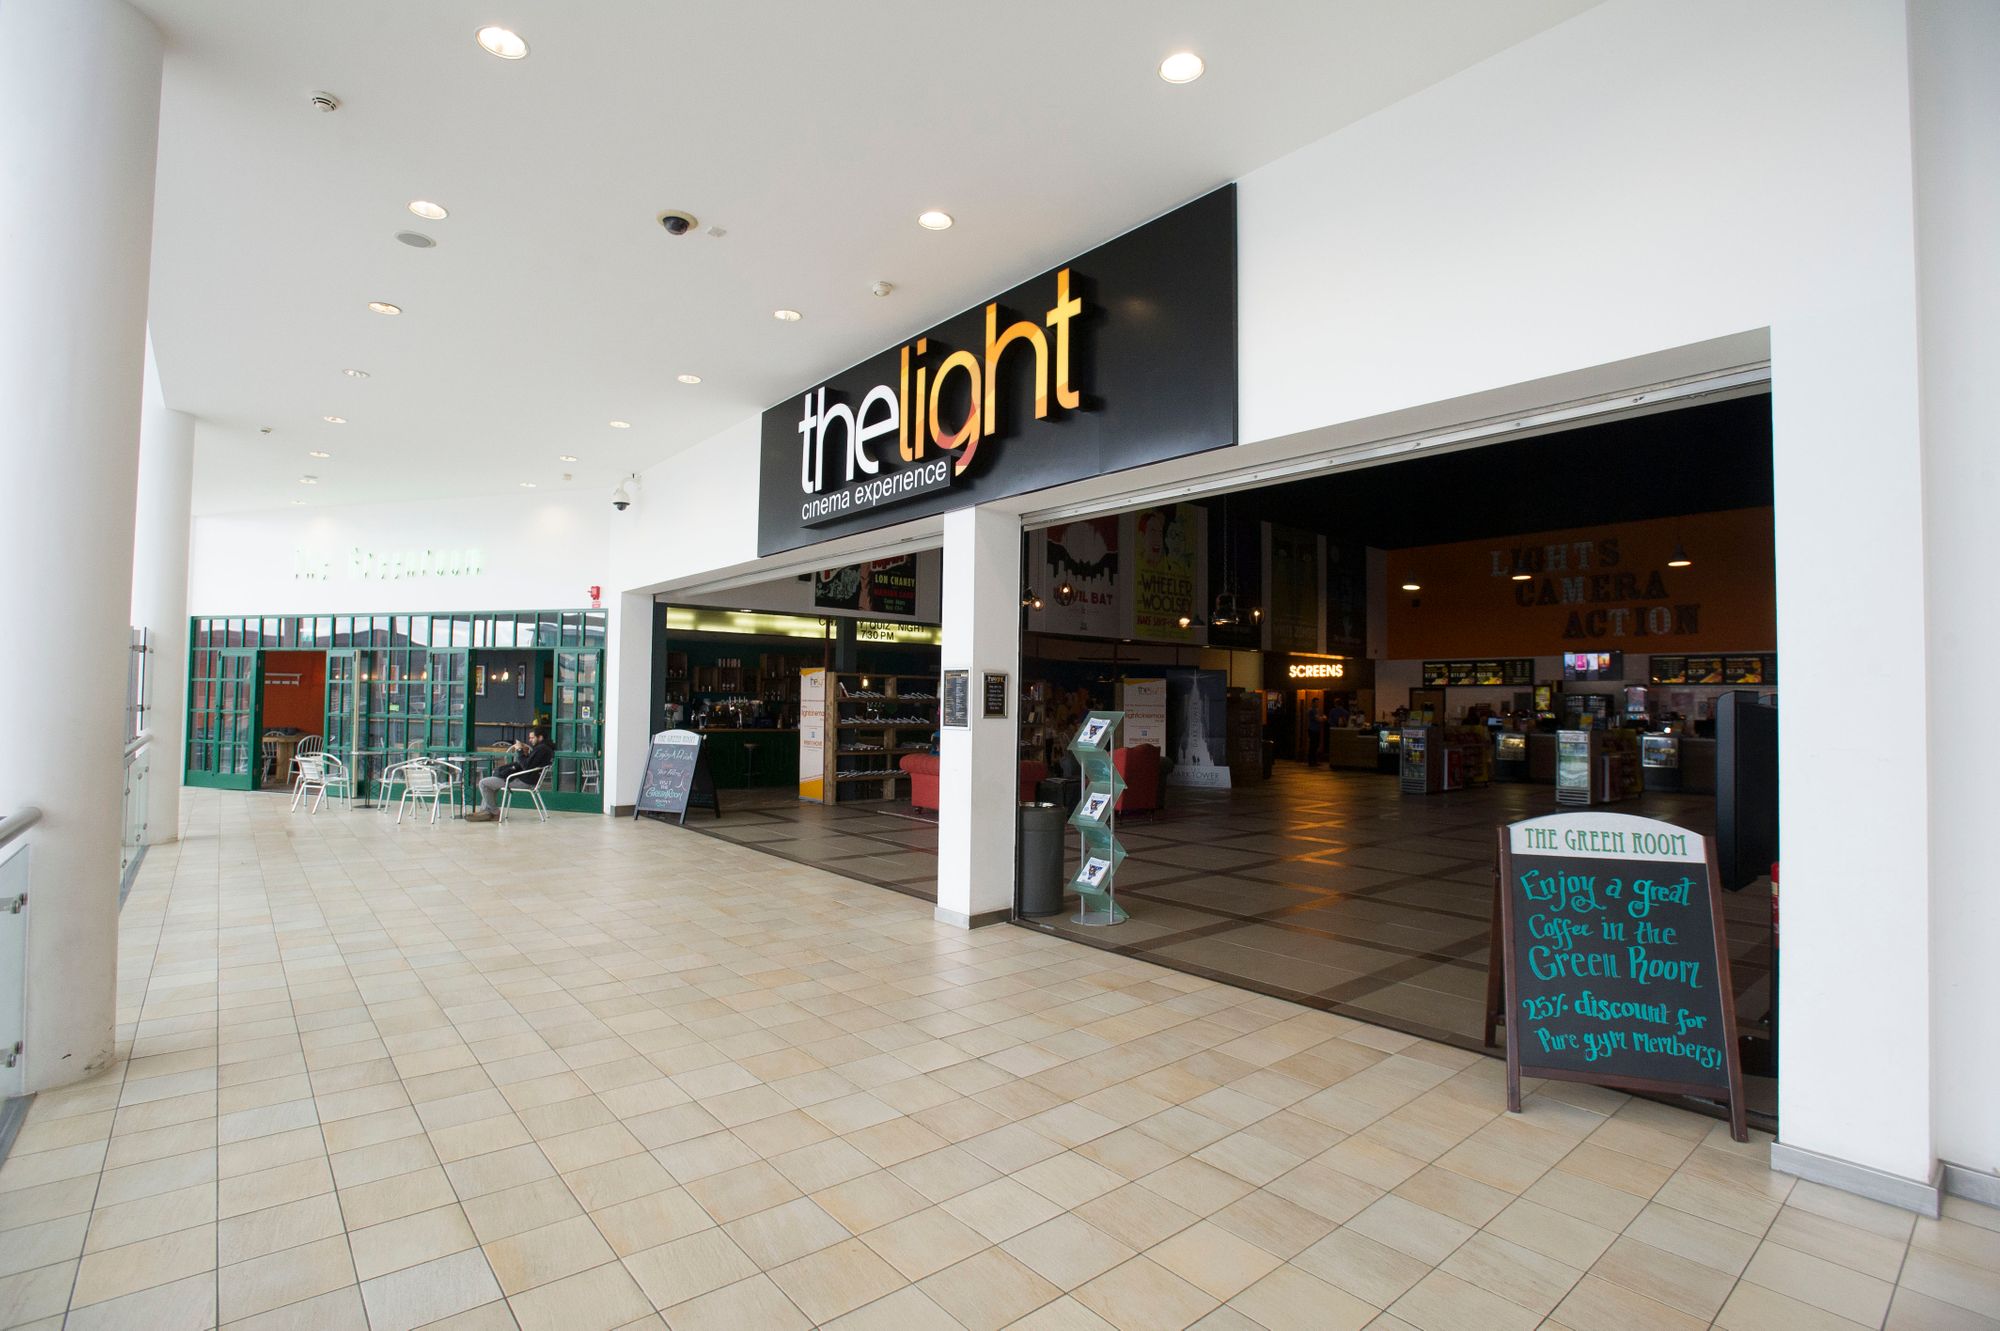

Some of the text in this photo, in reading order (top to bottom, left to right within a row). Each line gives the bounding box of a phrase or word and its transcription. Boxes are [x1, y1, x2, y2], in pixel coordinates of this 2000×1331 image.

[802, 461, 947, 520] cinema experience
[875, 574, 916, 588] LON CHANEY
[1514, 570, 1671, 607] CAMERA
[1091, 592, 1113, 606] BAT
[869, 622, 891, 631] QUIZ
[897, 624, 926, 633] NIGHT
[880, 631, 895, 641] PM
[1561, 603, 1701, 640] ACTION
[1288, 664, 1344, 678] SCREENS
[1525, 828, 1688, 856] THE GREEN ROOM
[1520, 869, 1697, 919] Enjoy a great
[1528, 914, 1679, 951] Coffee in the
[1528, 945, 1704, 989] Green Room
[1522, 990, 1708, 1036] 25% discount for
[1533, 1027, 1580, 1054] Pure
